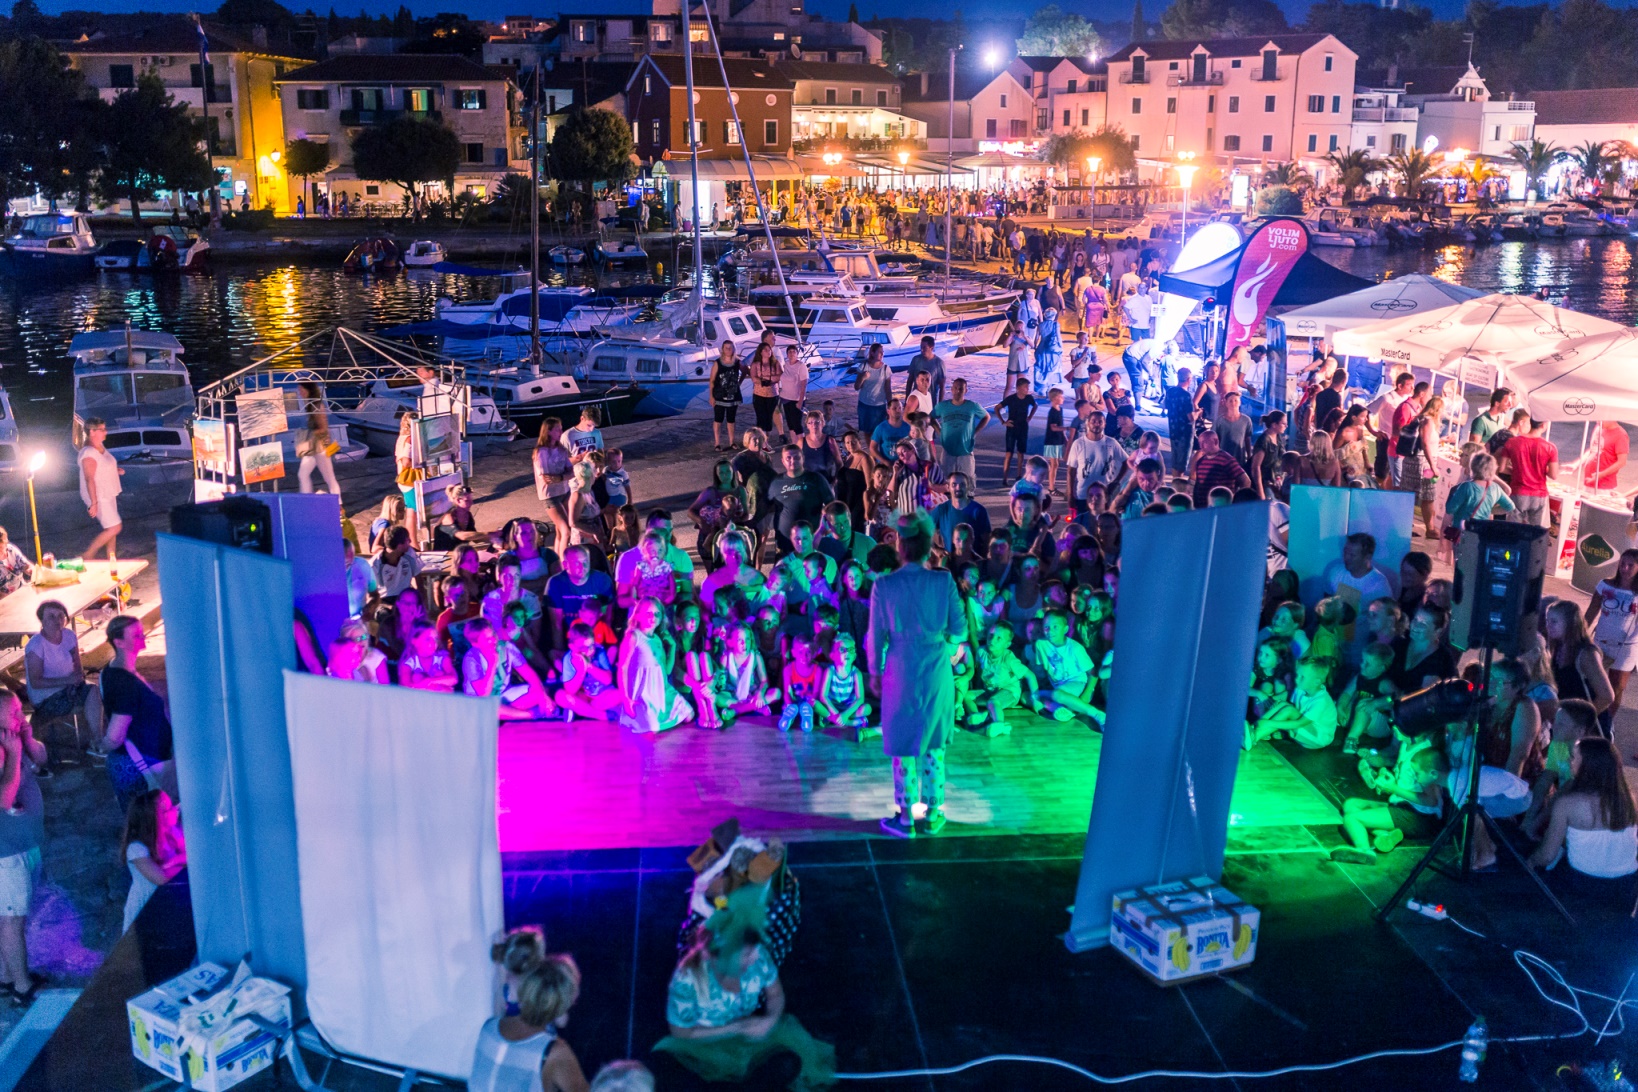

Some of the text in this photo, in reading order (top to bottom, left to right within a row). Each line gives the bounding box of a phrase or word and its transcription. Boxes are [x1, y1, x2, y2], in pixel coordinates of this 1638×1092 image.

[1268, 227, 1300, 238] VOLIM
[1268, 235, 1299, 248] LJUTO
[1276, 243, 1297, 251] .com
[1380, 347, 1411, 361] MasterCard
[1581, 541, 1611, 560] Aurelia
[1196, 931, 1230, 956] BONITA
